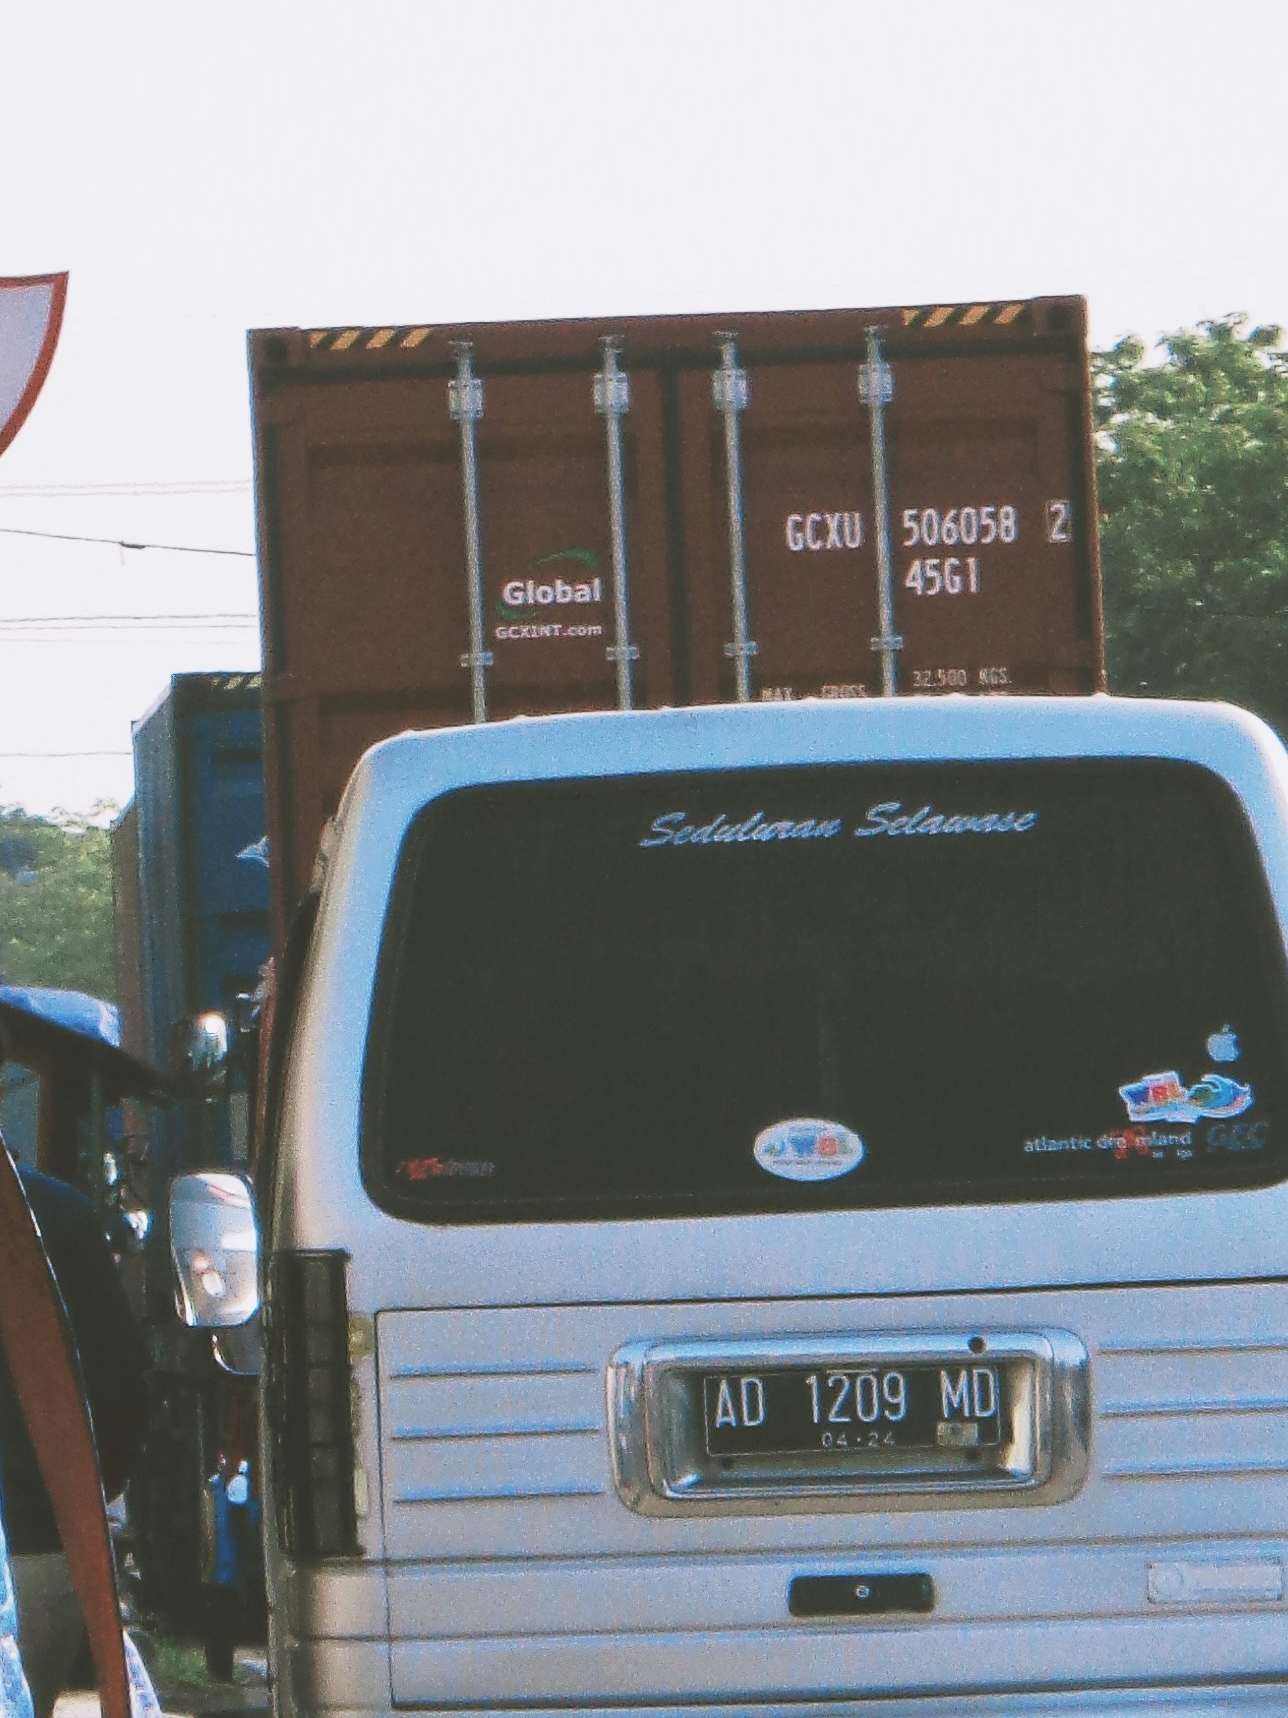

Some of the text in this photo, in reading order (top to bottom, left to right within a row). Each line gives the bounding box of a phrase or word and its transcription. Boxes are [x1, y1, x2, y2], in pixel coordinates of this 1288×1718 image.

[785, 501, 1071, 551] GCXU 506058 2
[502, 576, 602, 605] Global
[905, 557, 981, 596] 45G1
[495, 624, 604, 640] GCXINT.com
[715, 1367, 997, 1428] AD 1209 MD
